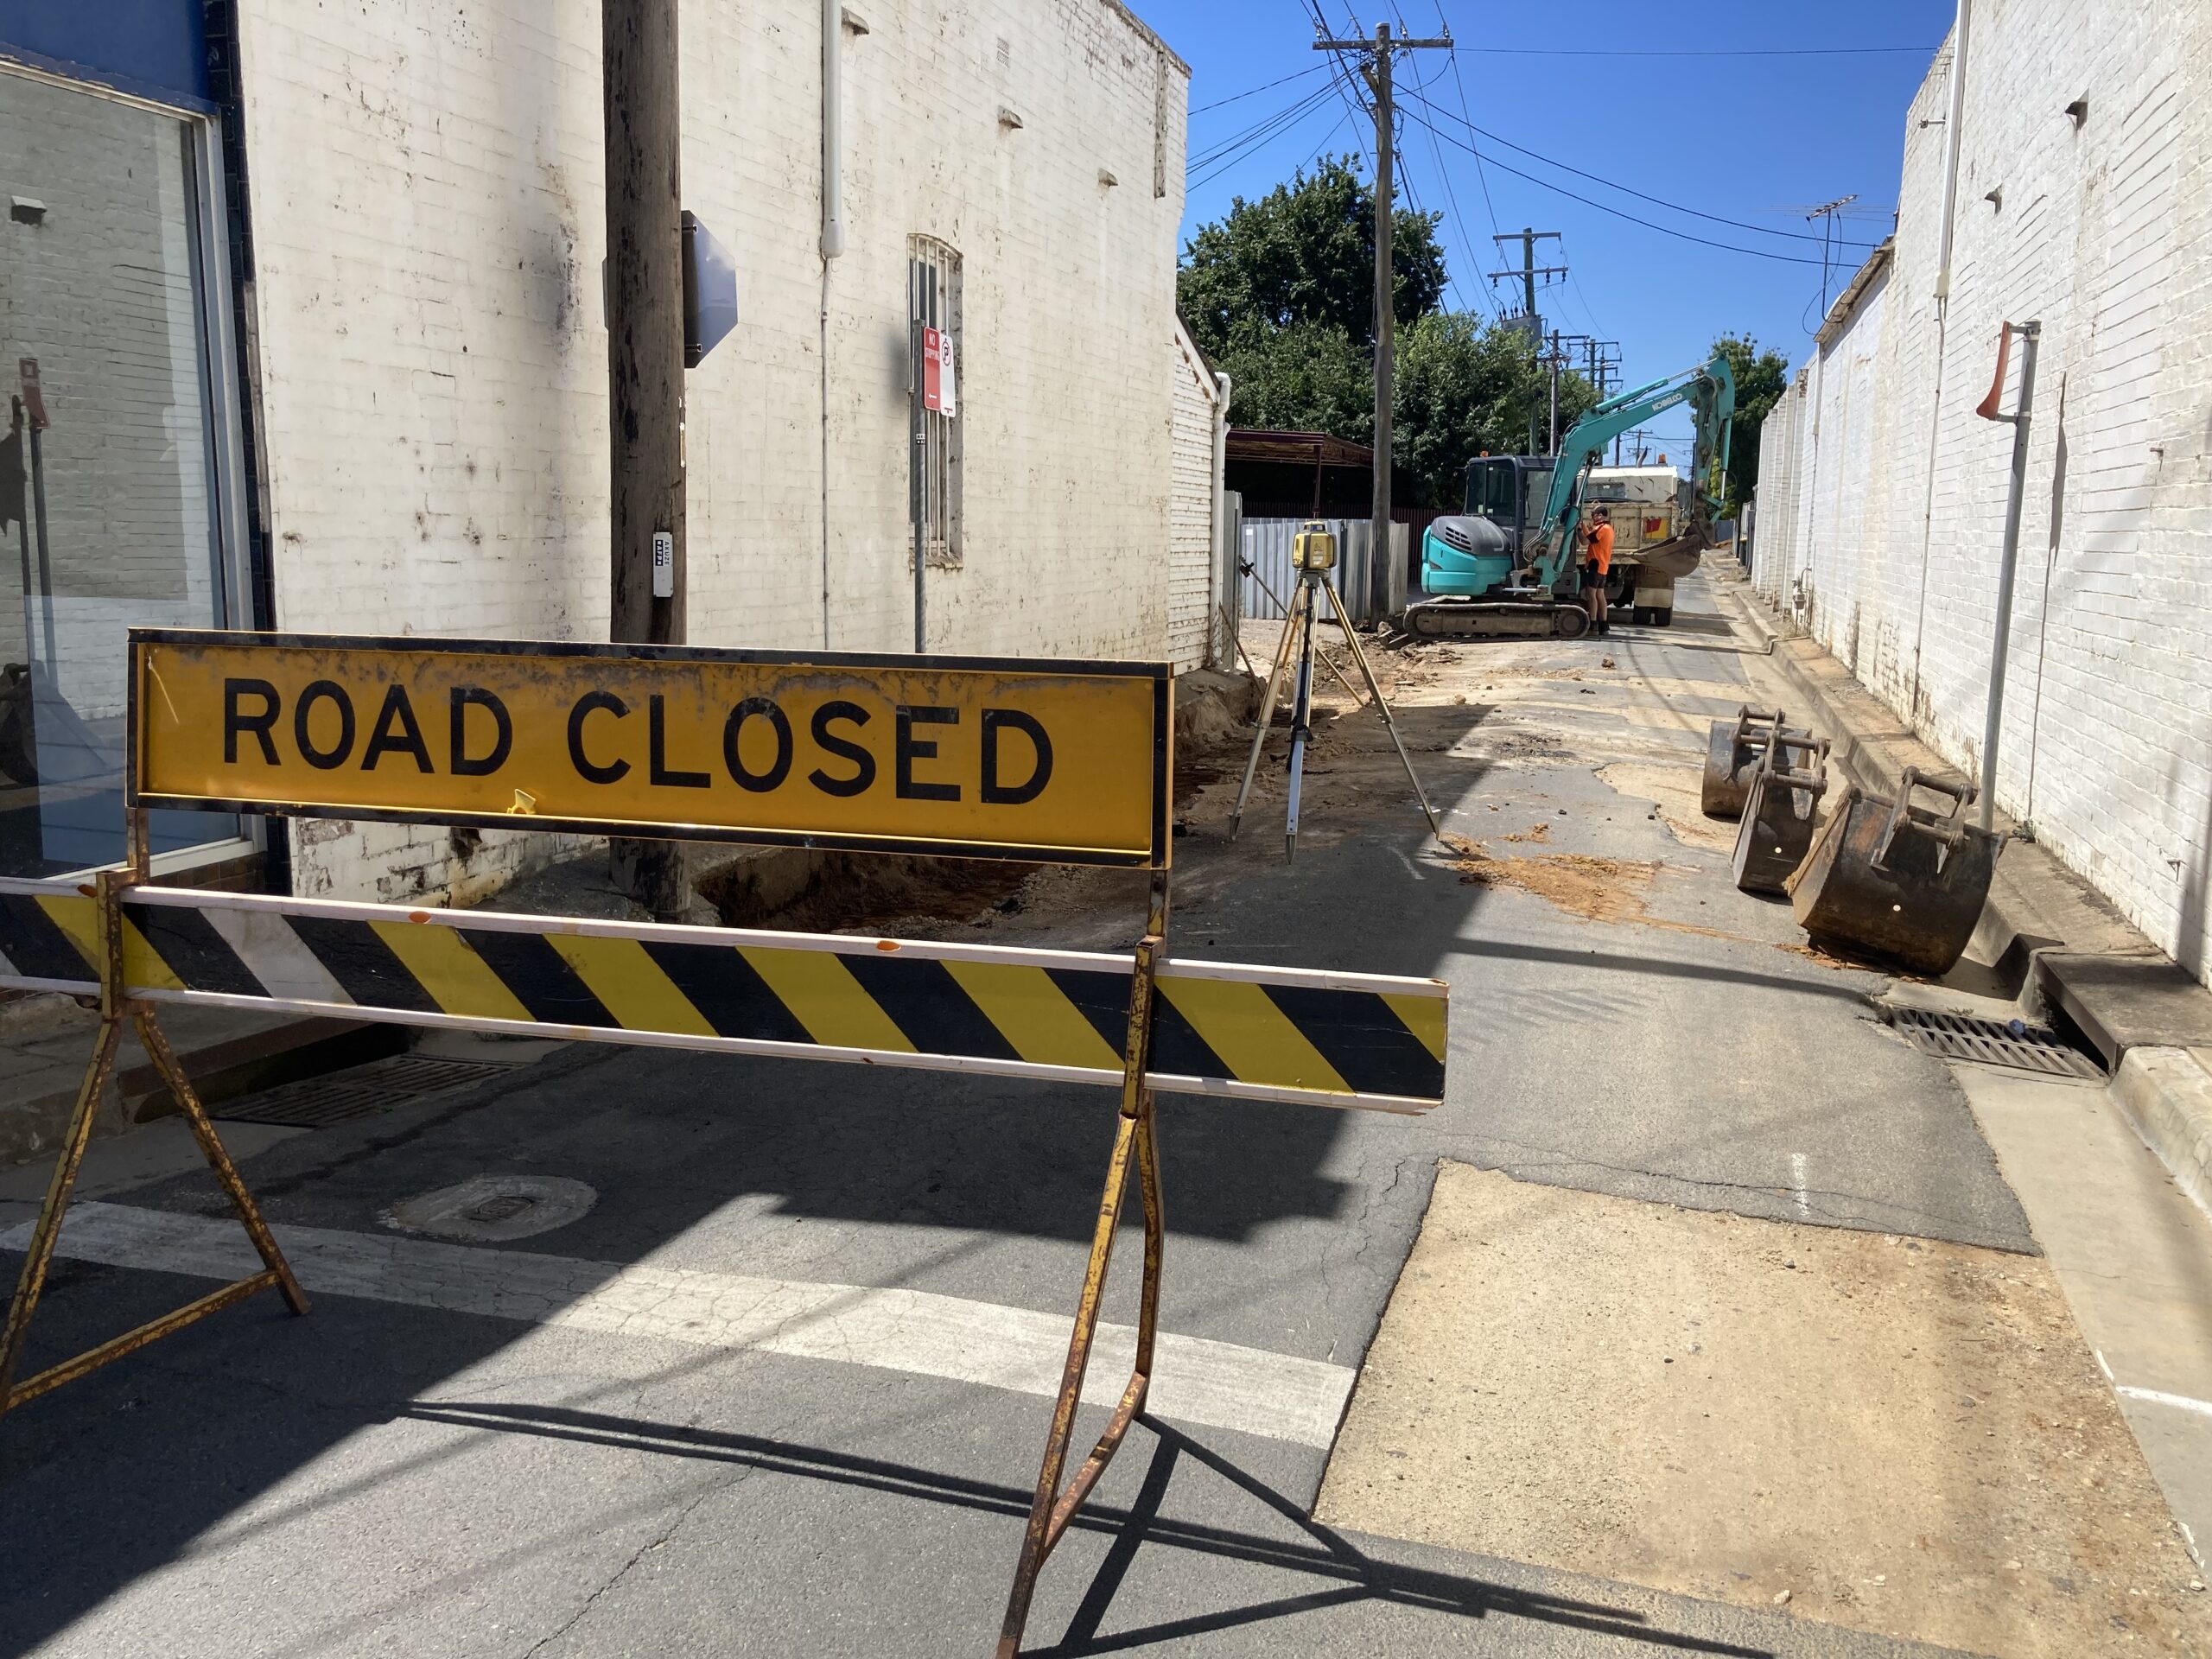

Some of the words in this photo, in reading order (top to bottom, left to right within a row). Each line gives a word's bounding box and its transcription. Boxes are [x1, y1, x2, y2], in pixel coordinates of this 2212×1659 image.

[928, 333, 936, 346] NO
[1652, 393, 1683, 411] KOBELCO
[224, 677, 512, 776] ROAD
[568, 690, 1053, 804] CLOSED
